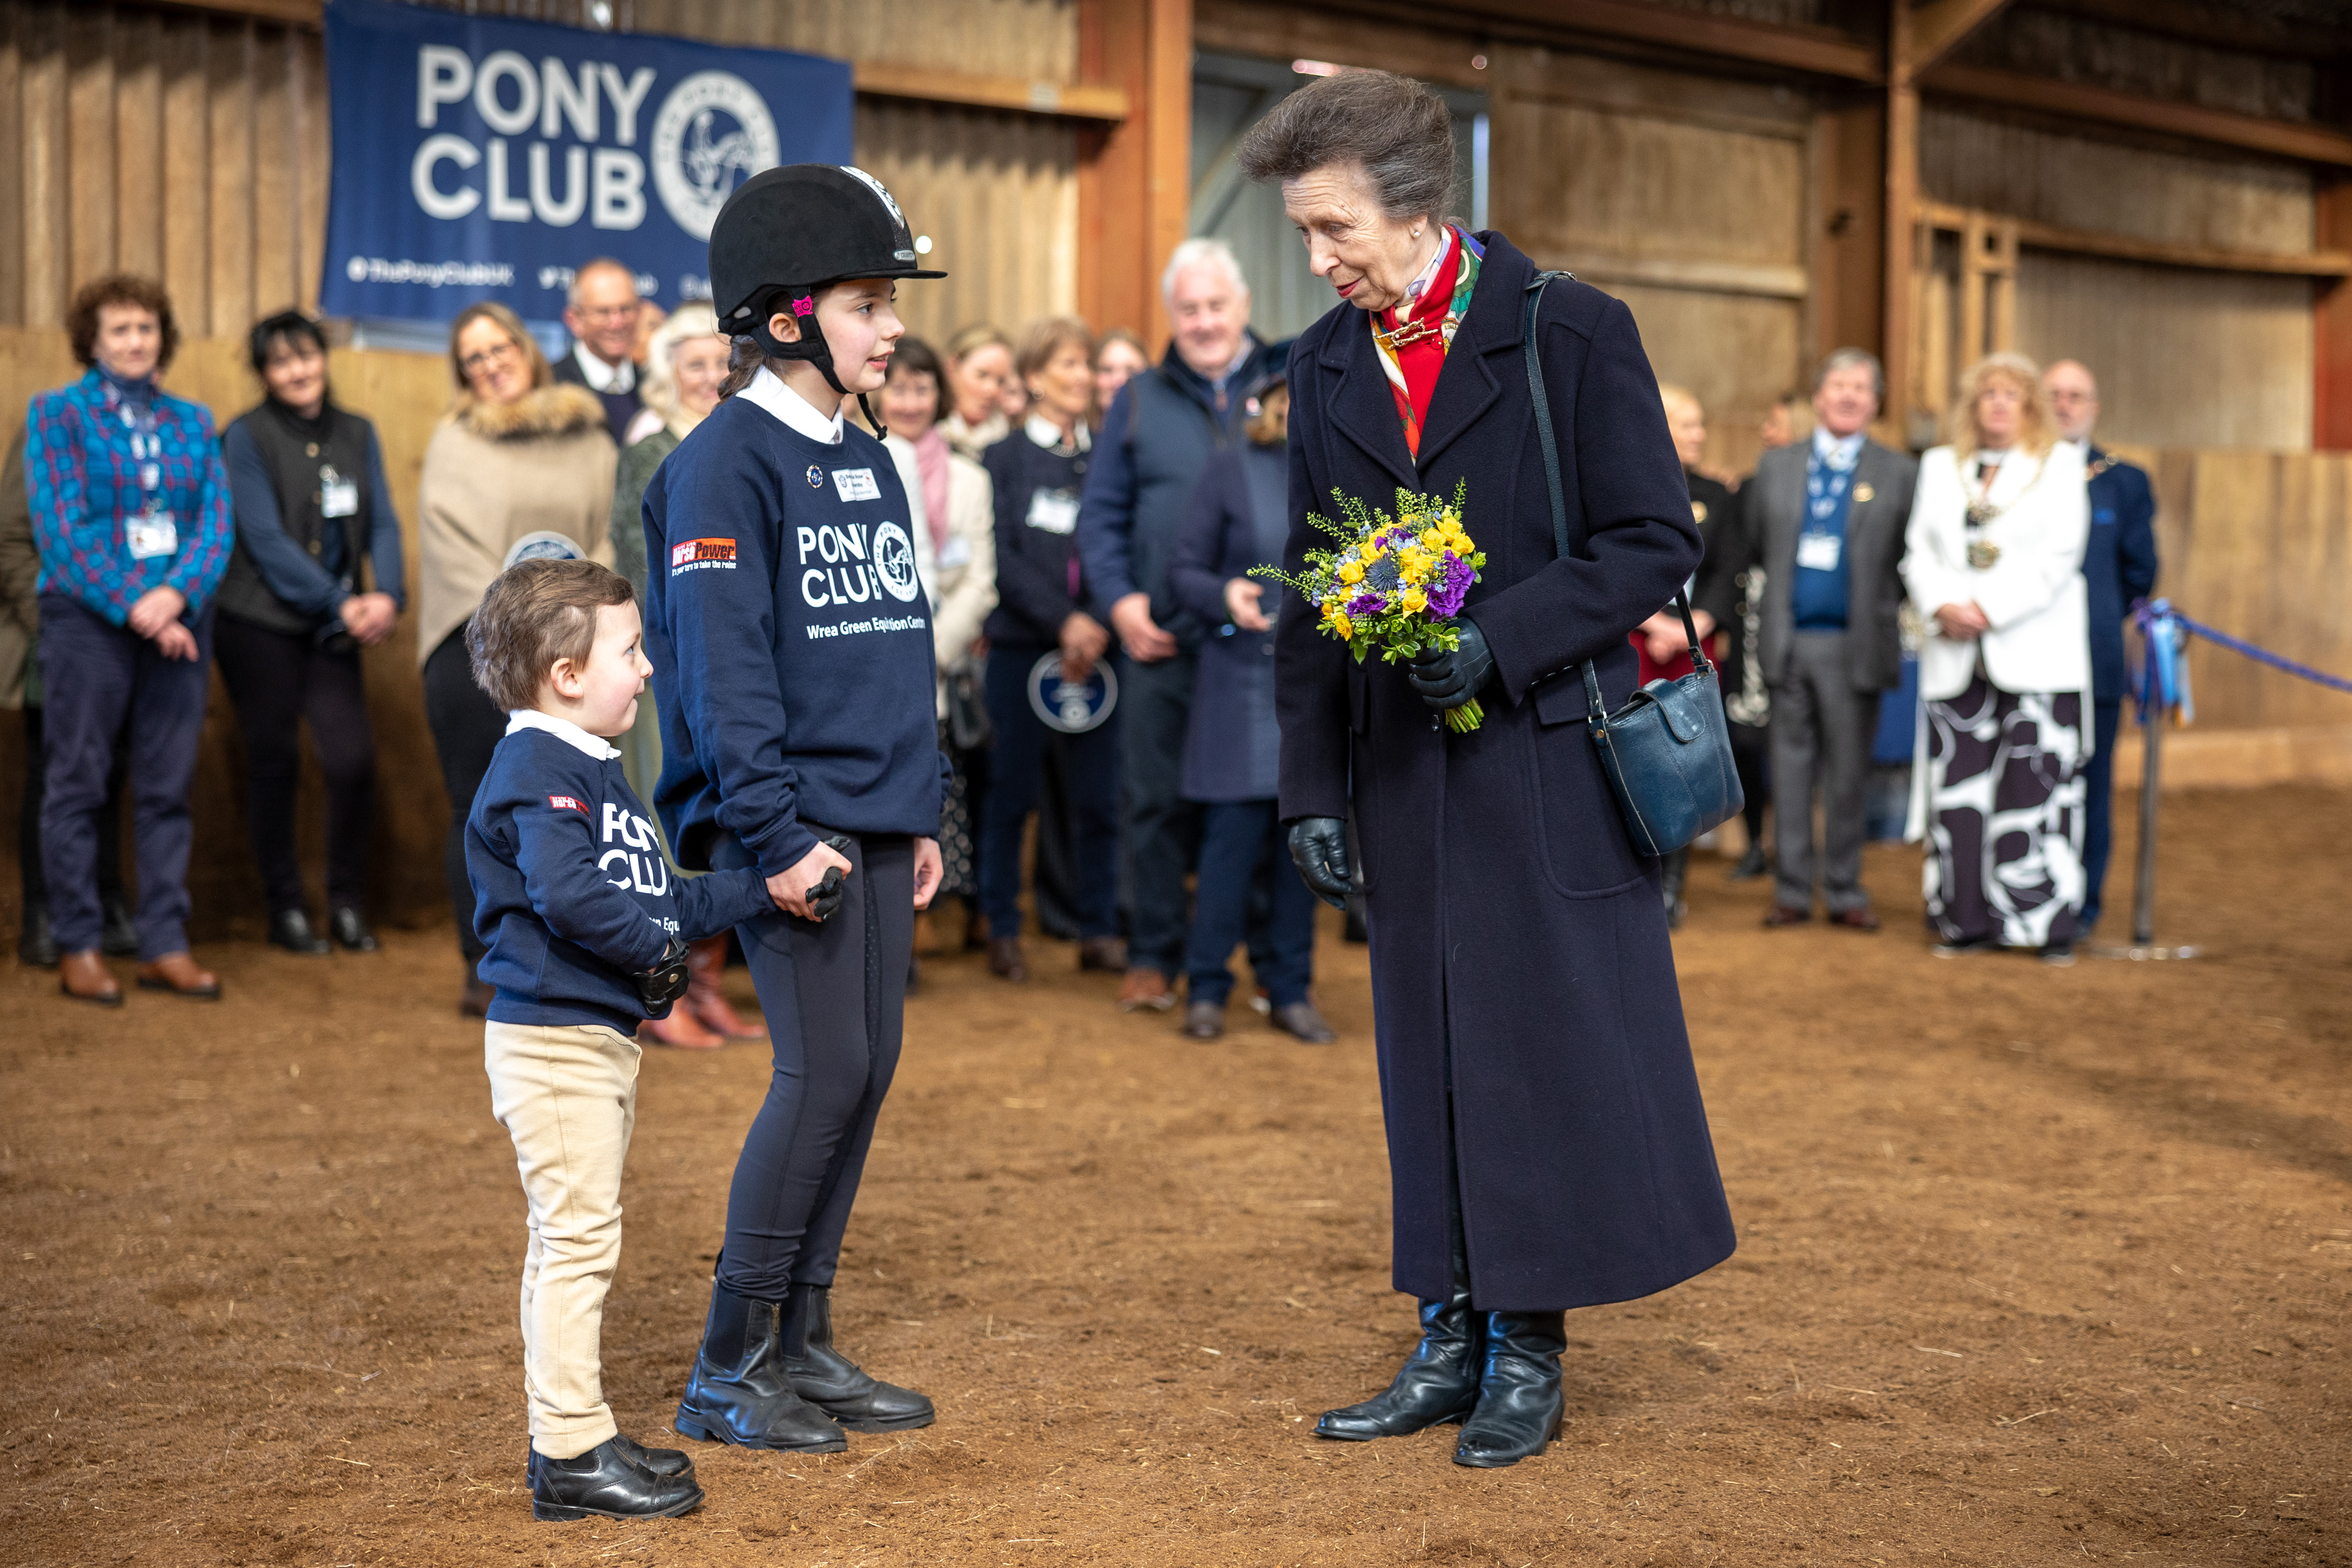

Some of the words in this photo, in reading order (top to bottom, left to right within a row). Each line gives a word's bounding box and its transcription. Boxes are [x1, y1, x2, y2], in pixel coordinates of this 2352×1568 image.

[416, 44, 658, 145] PONY
[411, 133, 647, 231] CLUB
[797, 523, 871, 565] PONY
[880, 526, 896, 538] PONY
[699, 560, 711, 569] take
[711, 560, 721, 569] the
[721, 561, 736, 569] reins
[802, 564, 882, 607] CLUB
[807, 625, 839, 639] Wrea
[840, 621, 873, 635] Green
[603, 802, 661, 852] PON
[598, 849, 673, 896] CLU
[663, 916, 680, 935] Equ
